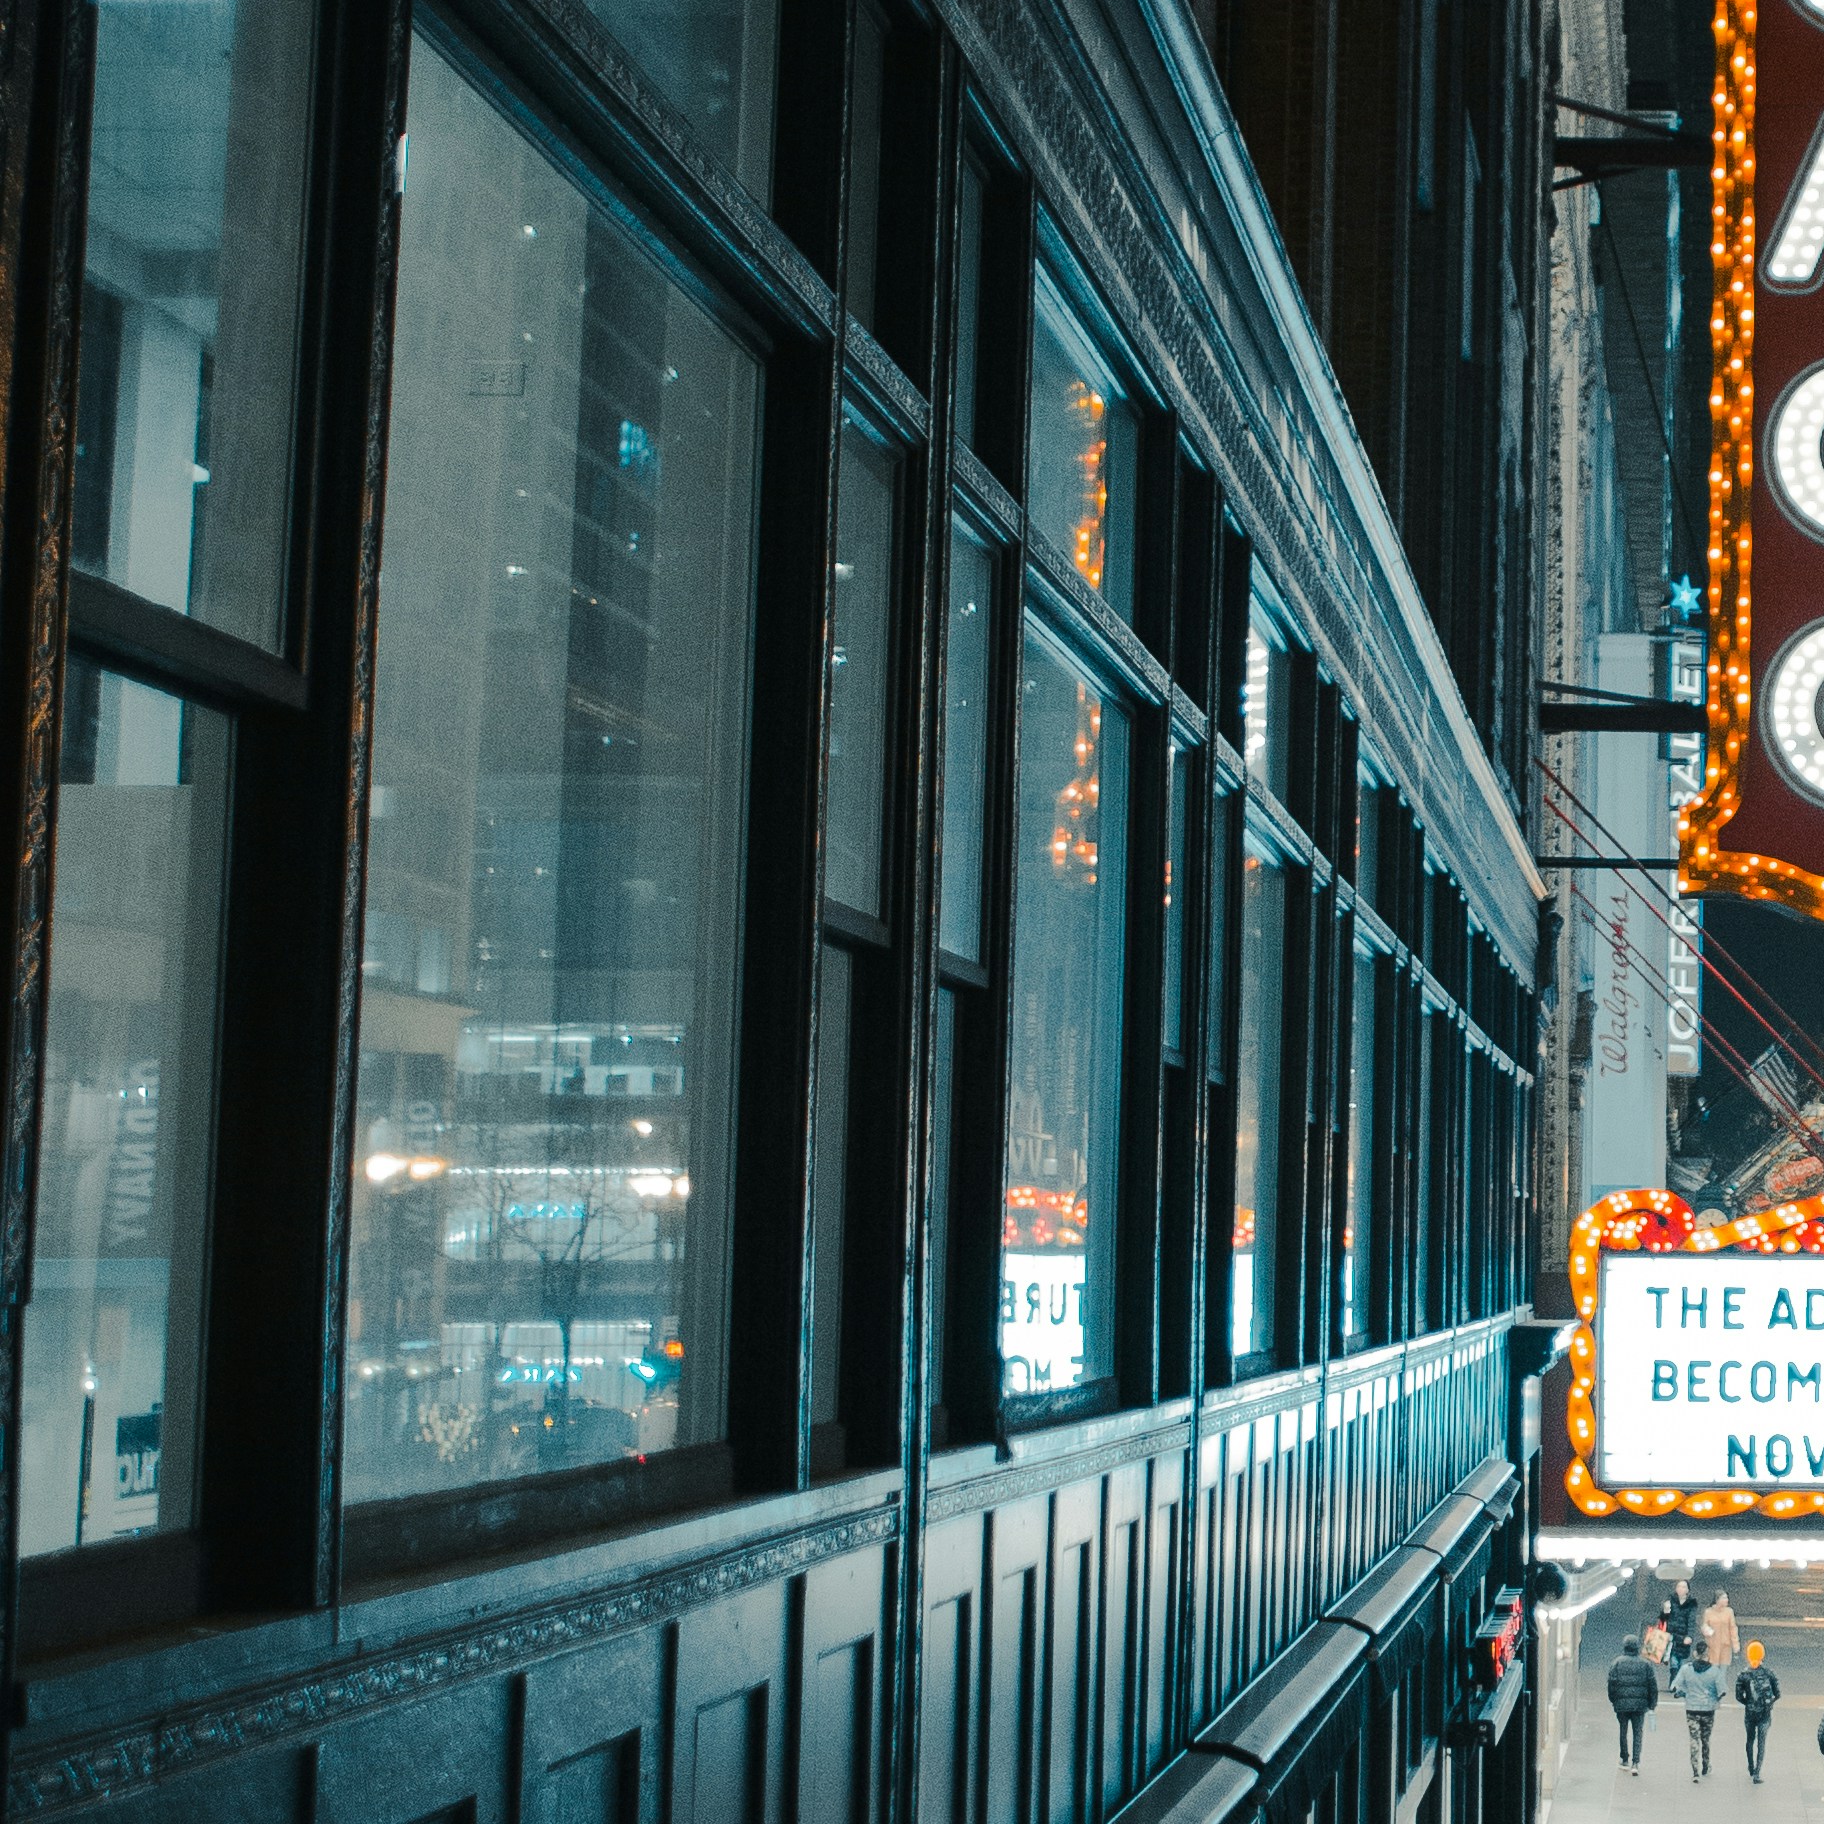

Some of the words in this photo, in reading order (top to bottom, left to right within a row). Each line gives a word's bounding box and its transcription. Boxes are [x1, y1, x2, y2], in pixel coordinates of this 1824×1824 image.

[1671, 642, 1700, 808] BALET
[1599, 887, 1640, 1078] Walgreens
[1669, 834, 1698, 1068] JOFFR
[1646, 1286, 1747, 1330] THE
